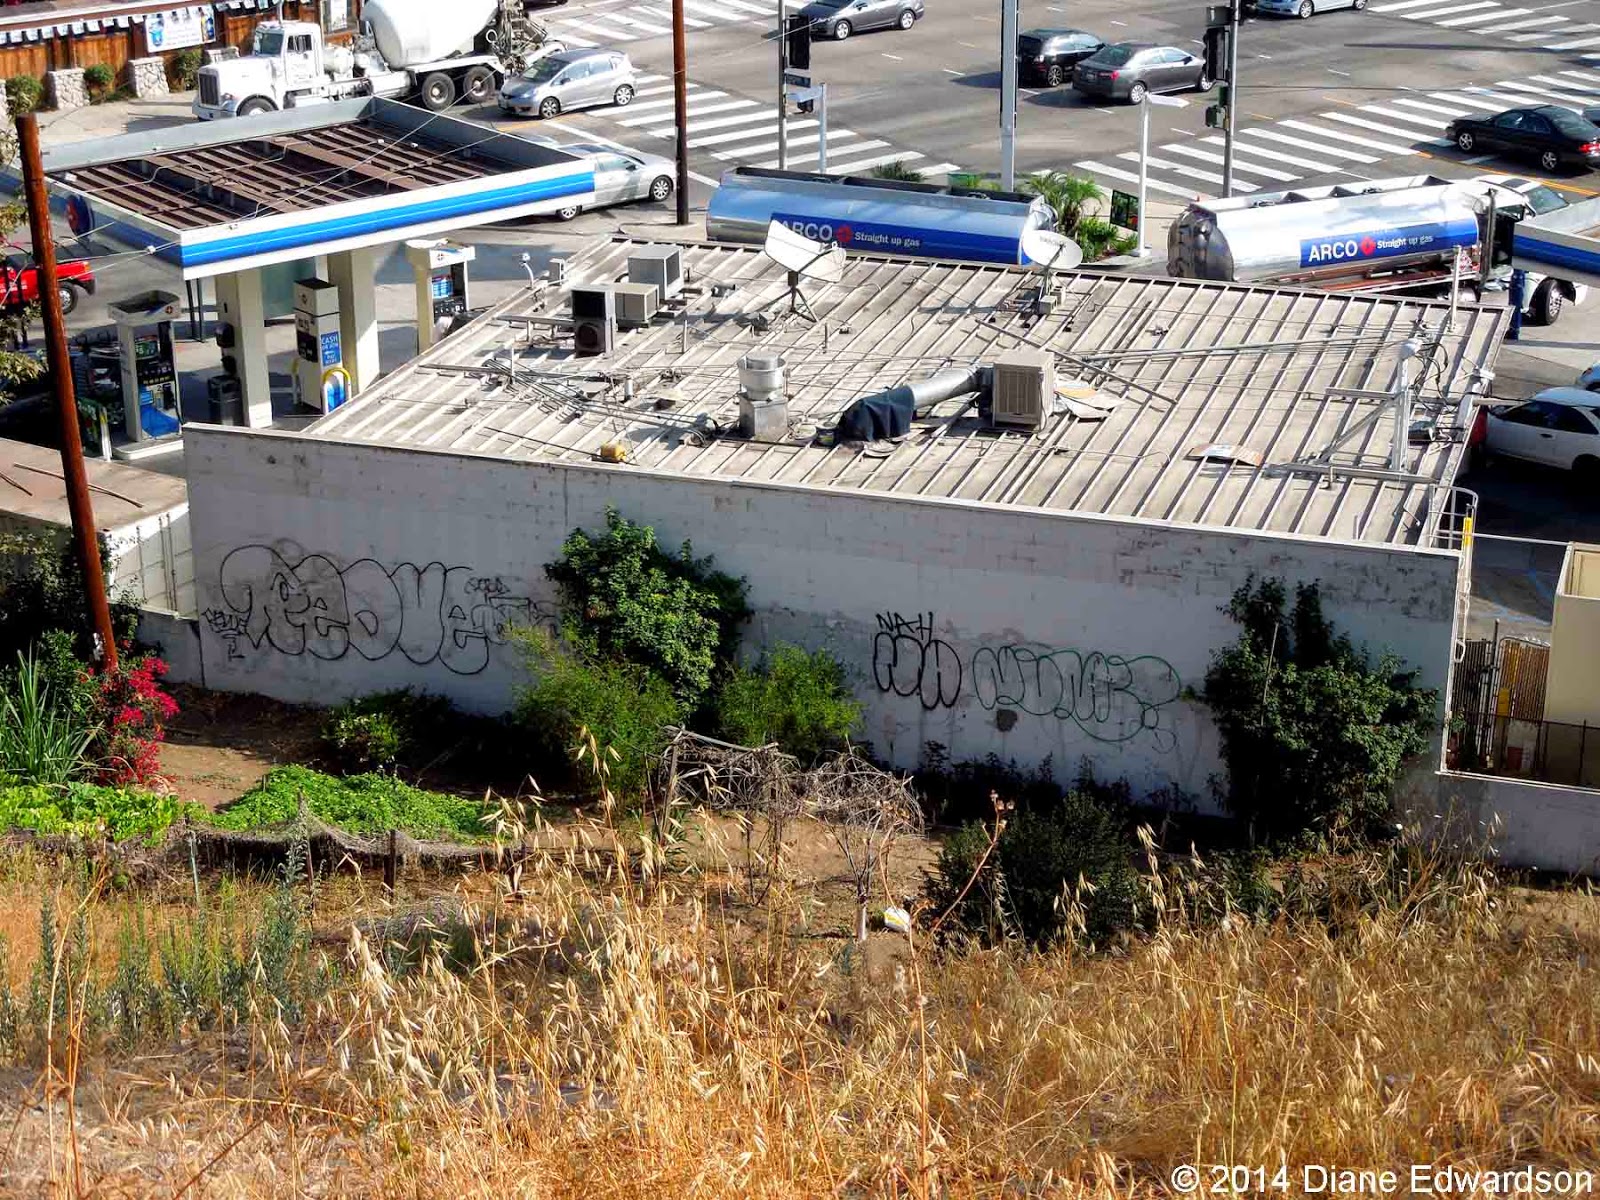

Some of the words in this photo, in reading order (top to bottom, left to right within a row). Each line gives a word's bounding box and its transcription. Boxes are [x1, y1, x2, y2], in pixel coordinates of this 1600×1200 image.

[854, 231, 889, 244] Straight
[891, 237, 902, 247] up
[903, 238, 920, 248] gas
[1308, 240, 1359, 262] ARCO
[1377, 238, 1407, 249] Straight
[1408, 236, 1418, 246] up
[1420, 235, 1434, 246] gas
